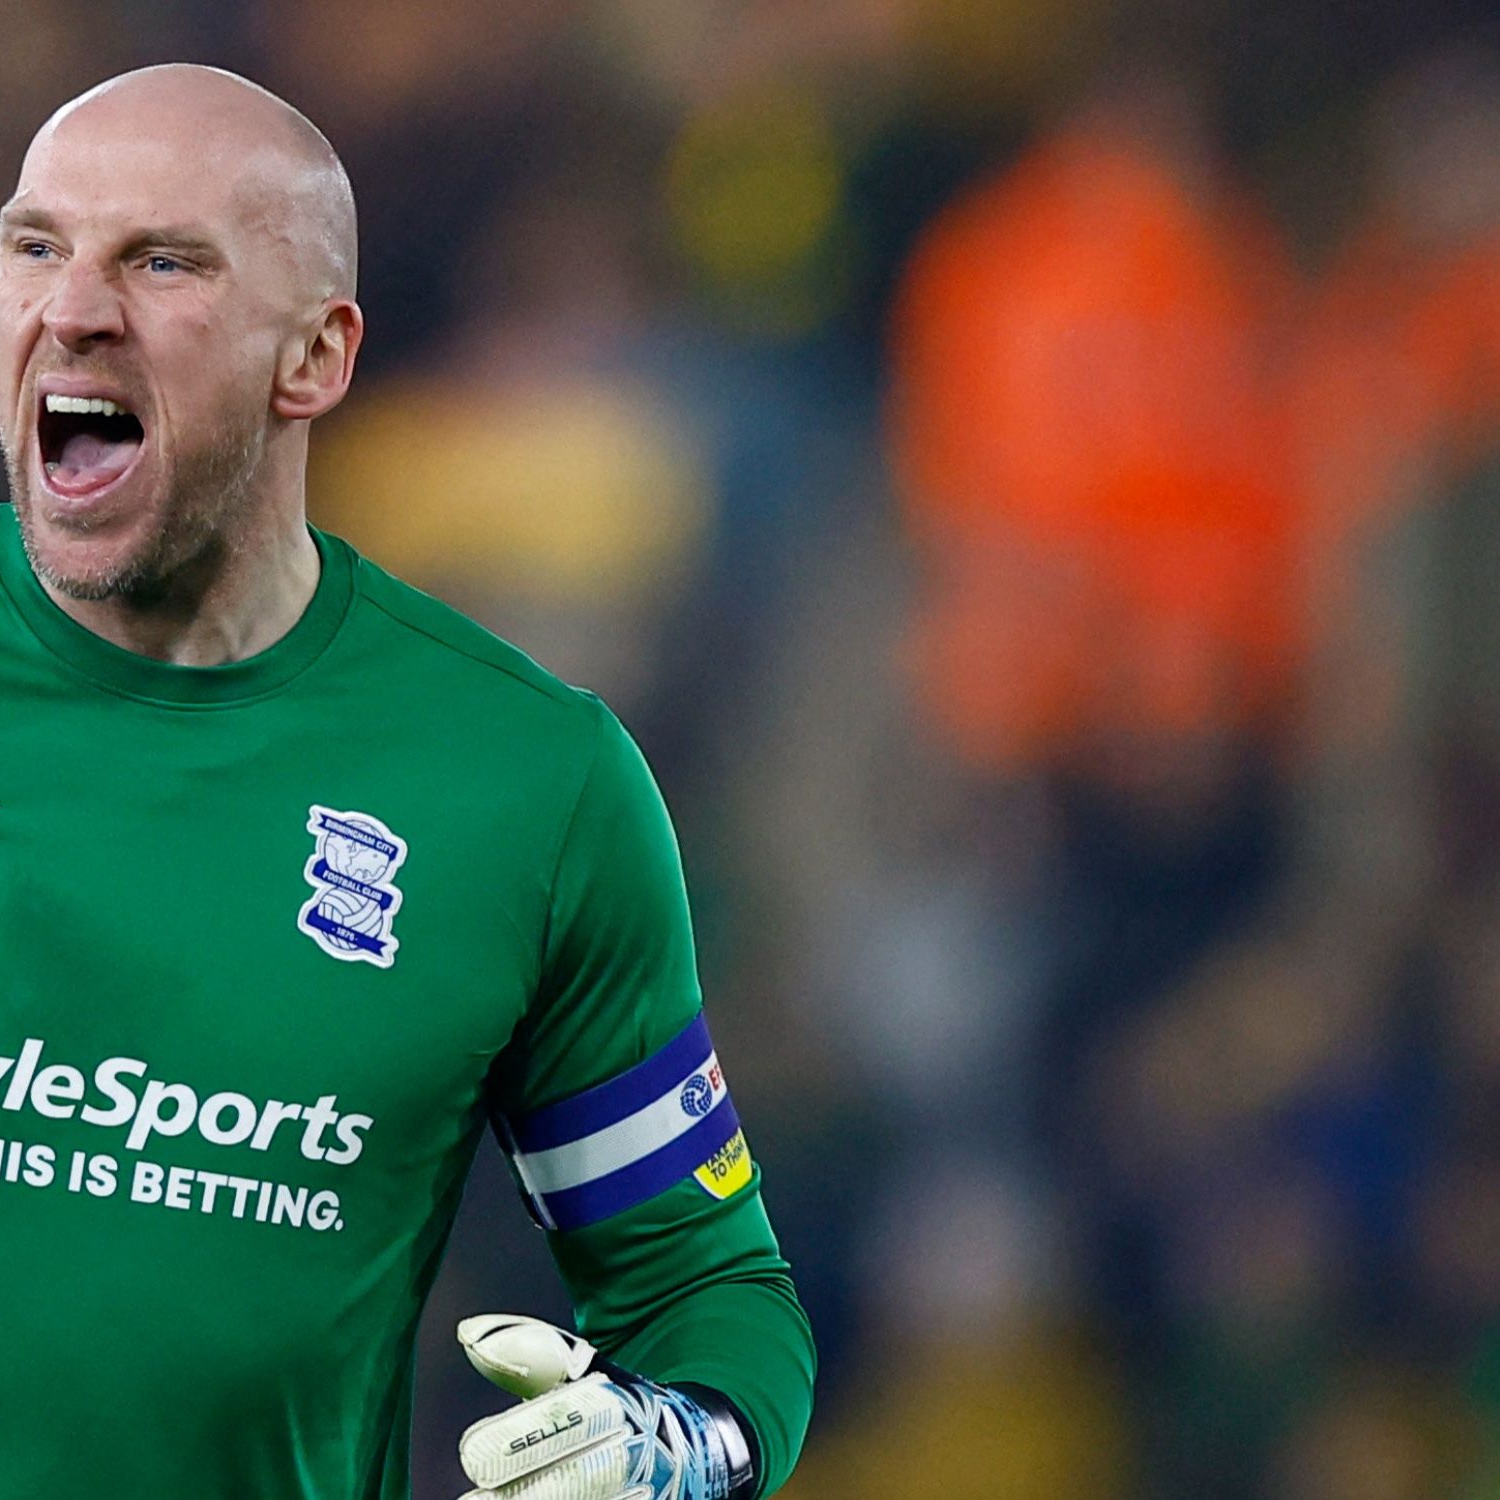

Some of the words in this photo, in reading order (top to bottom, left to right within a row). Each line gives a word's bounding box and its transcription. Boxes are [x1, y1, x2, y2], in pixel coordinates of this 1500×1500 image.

[376, 839, 396, 854] CITY
[322, 869, 361, 893] FOOTBALL
[362, 886, 383, 901] CLUB
[711, 1161, 727, 1182] TO
[68, 1151, 118, 1197] IS
[130, 1160, 345, 1232] BETTING.
[509, 1411, 583, 1450] SELLS
